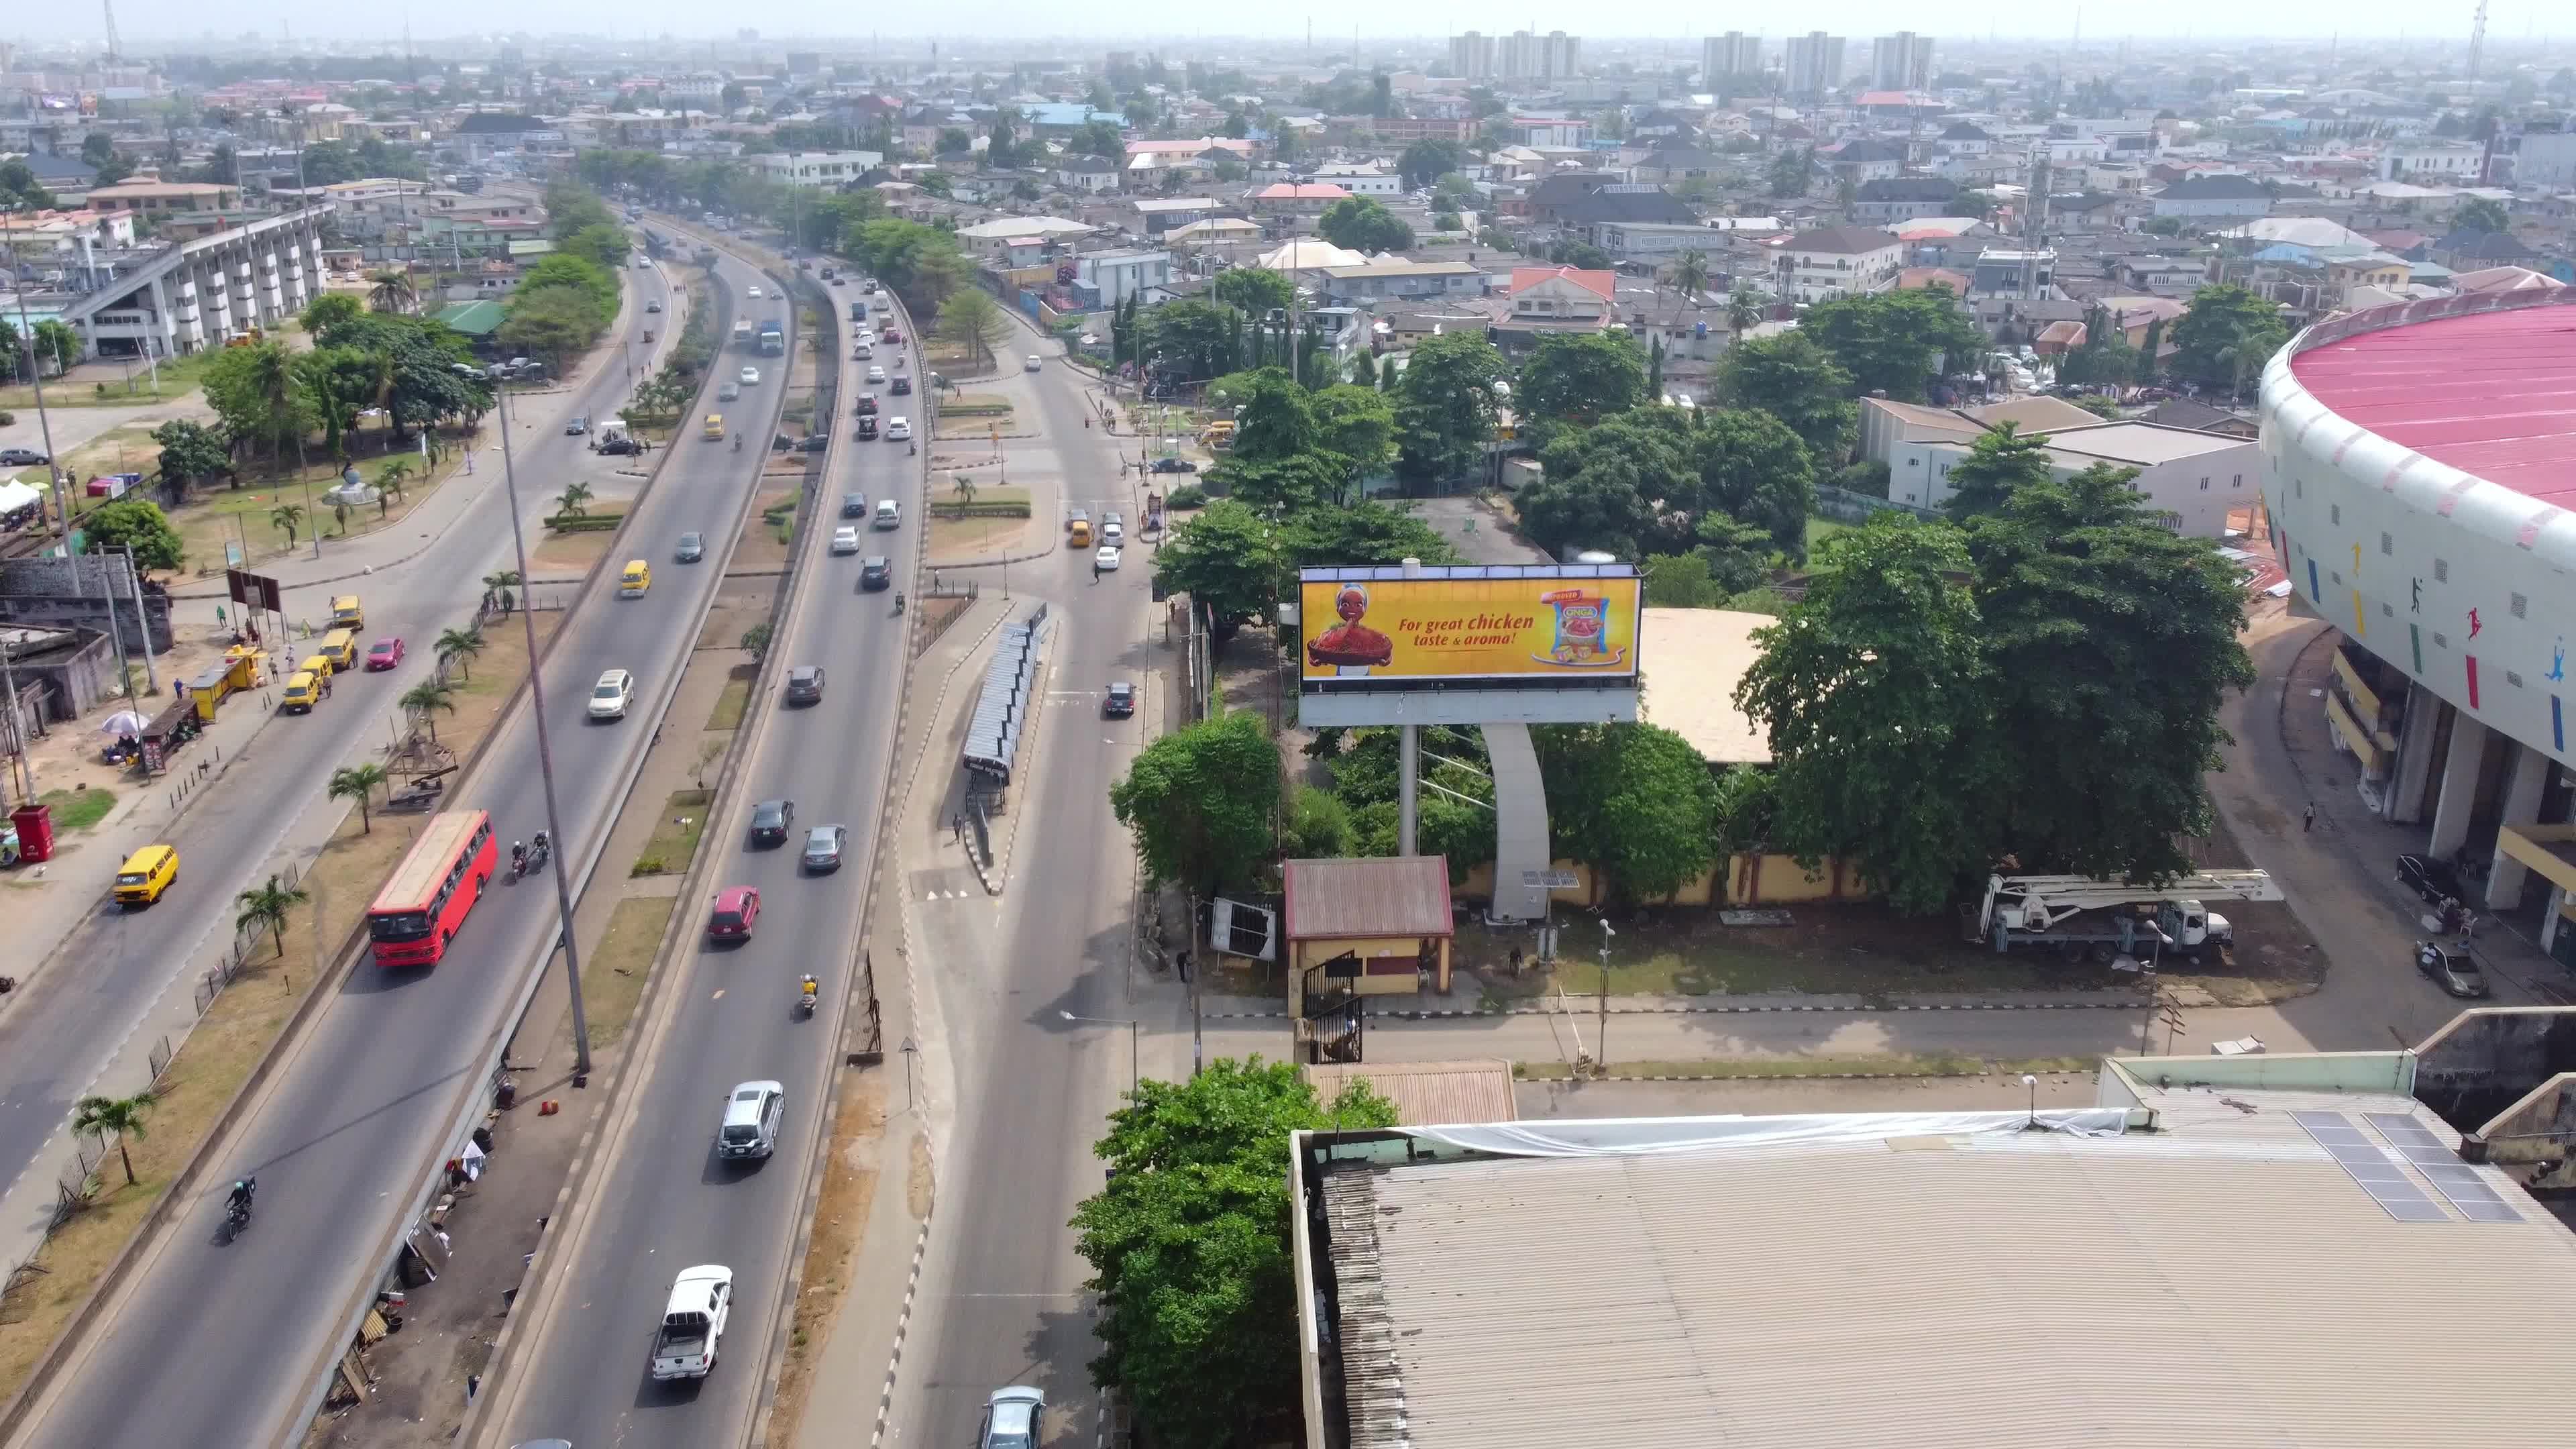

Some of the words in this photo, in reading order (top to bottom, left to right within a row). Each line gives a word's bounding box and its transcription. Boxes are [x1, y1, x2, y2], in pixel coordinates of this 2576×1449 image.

[1566, 608, 1594, 616] ONGA
[1399, 619, 1422, 631] For
[1426, 619, 1463, 634] great
[1468, 613, 1534, 630] chicken
[1414, 635, 1449, 646] taste
[1464, 633, 1516, 645] aroma!
